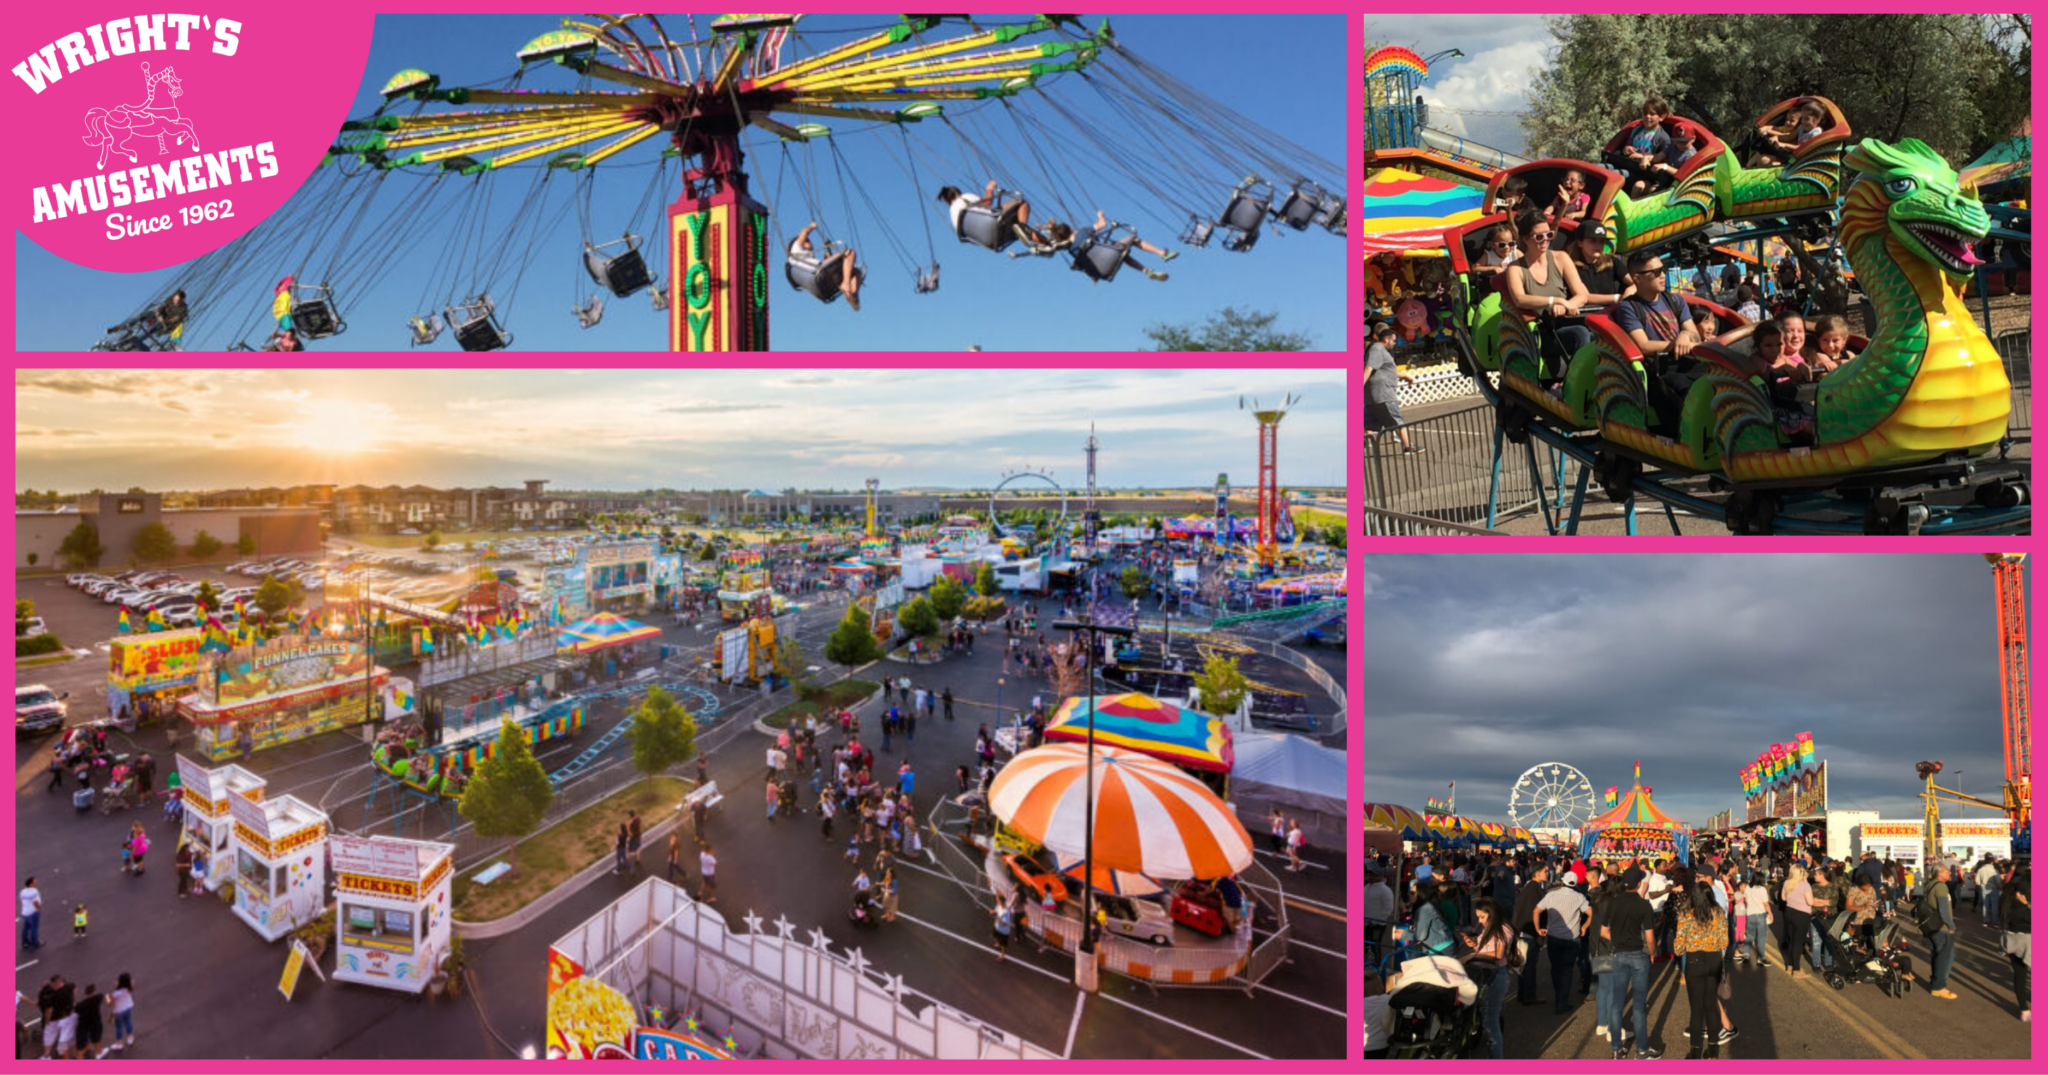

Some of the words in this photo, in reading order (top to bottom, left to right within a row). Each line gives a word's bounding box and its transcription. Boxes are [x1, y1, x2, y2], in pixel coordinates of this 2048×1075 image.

[254, 647, 306, 671] FUNNEL
[308, 642, 346, 658] CAKES
[280, 827, 319, 851] TICKETS
[1866, 826, 1918, 835] TICKETS
[1948, 826, 2004, 835] TICKETS
[343, 875, 413, 897] TICKETS
